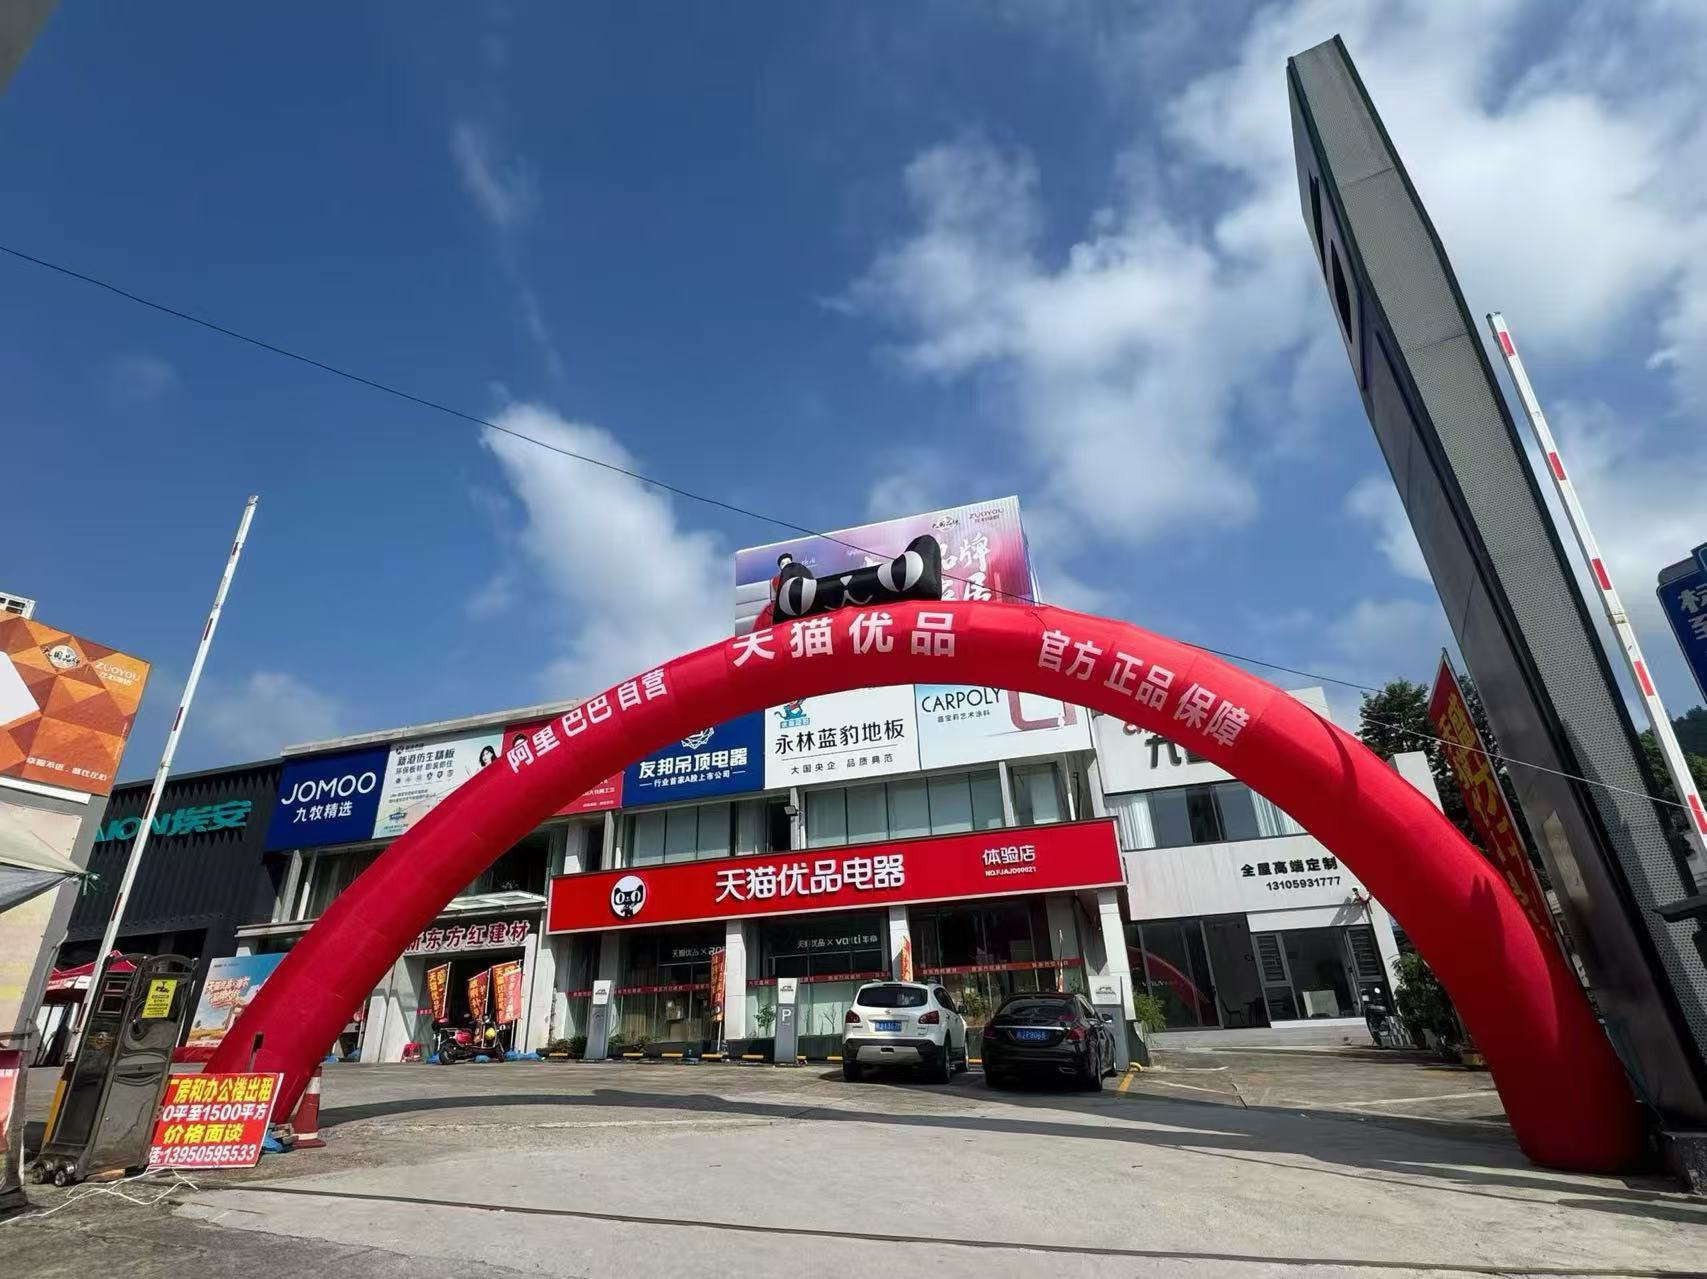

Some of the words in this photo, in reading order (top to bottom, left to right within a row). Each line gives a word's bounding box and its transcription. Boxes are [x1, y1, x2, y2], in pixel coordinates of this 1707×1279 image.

[732, 611, 956, 668] 天猫优品
[921, 686, 1001, 714] CARPOLY
[1037, 629, 1250, 748] 官方正品保障
[506, 668, 668, 774] 阿里巴巴自营
[774, 718, 905, 755] 永林蓝豹地板
[638, 747, 748, 779] 友邦吊顶电器
[790, 761, 837, 775] 大国央企
[846, 753, 894, 768] 品质典范
[280, 771, 377, 806] JOMOO
[653, 769, 731, 788] 行业首家A股上市公司
[293, 801, 353, 824] 九牧精选
[982, 844, 1036, 866] 体验店
[1240, 856, 1338, 878] 全屋高端定制
[715, 854, 905, 904] 天猫优品电器
[1265, 876, 1341, 891] 13105931777
[782, 1008, 792, 1022] P
[163, 1123, 245, 1144] 价格面谈
